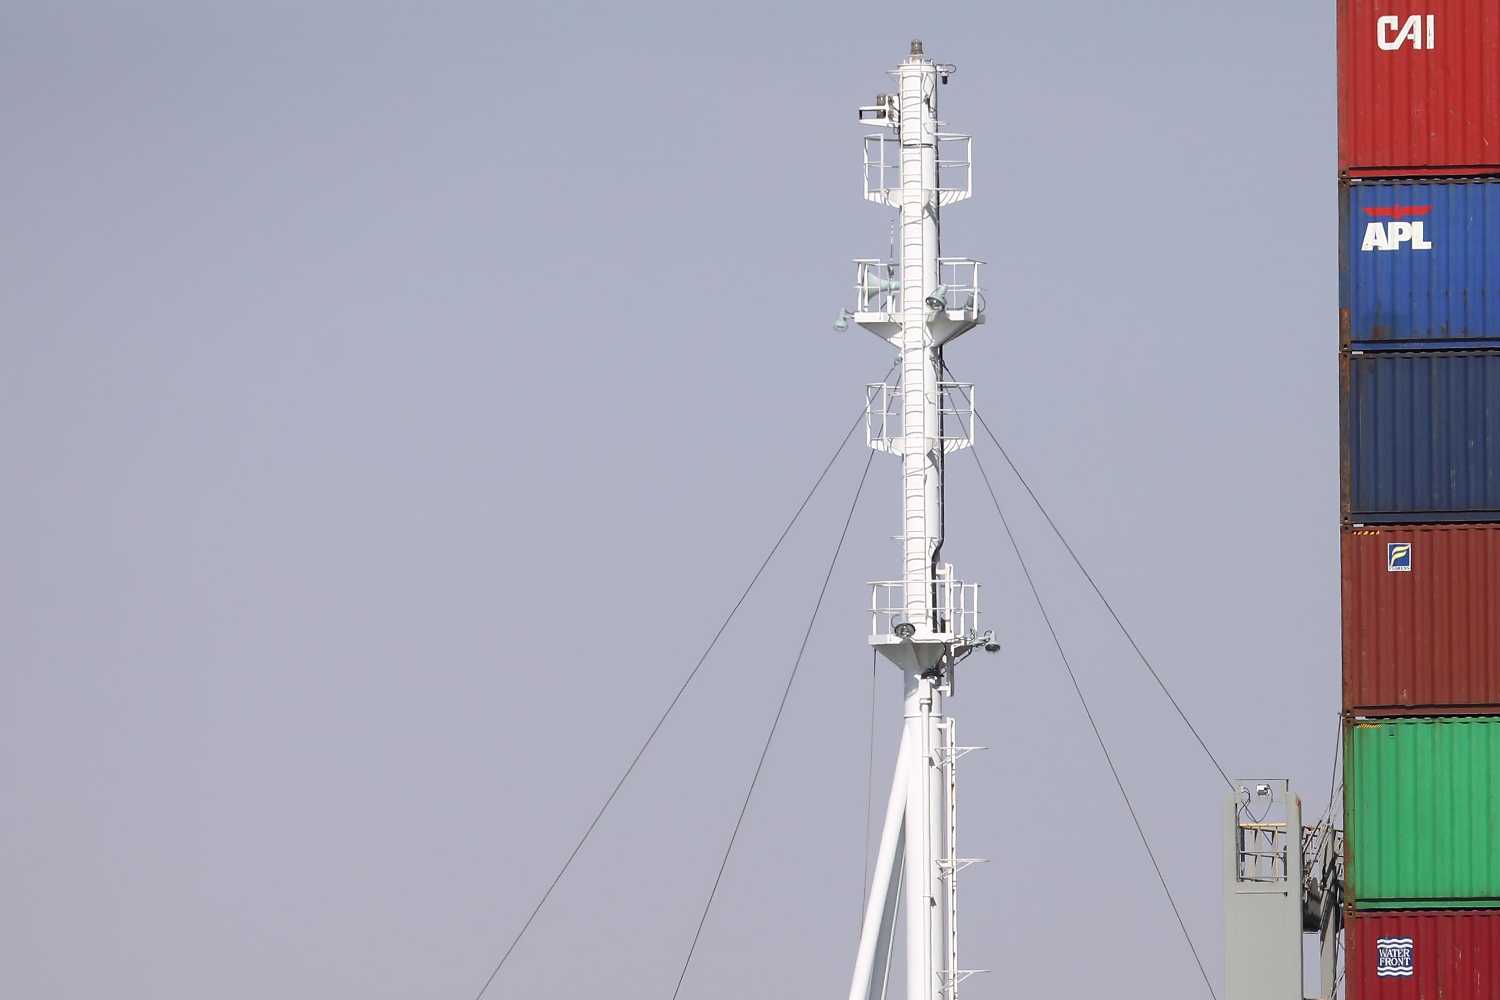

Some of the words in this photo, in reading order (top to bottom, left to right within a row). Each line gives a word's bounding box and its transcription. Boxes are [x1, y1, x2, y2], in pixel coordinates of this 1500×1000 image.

[1377, 15, 1436, 51] CAI
[1361, 221, 1433, 251] APL
[1379, 949, 1411, 958] WATER
[1379, 958, 1411, 967] FRONT
